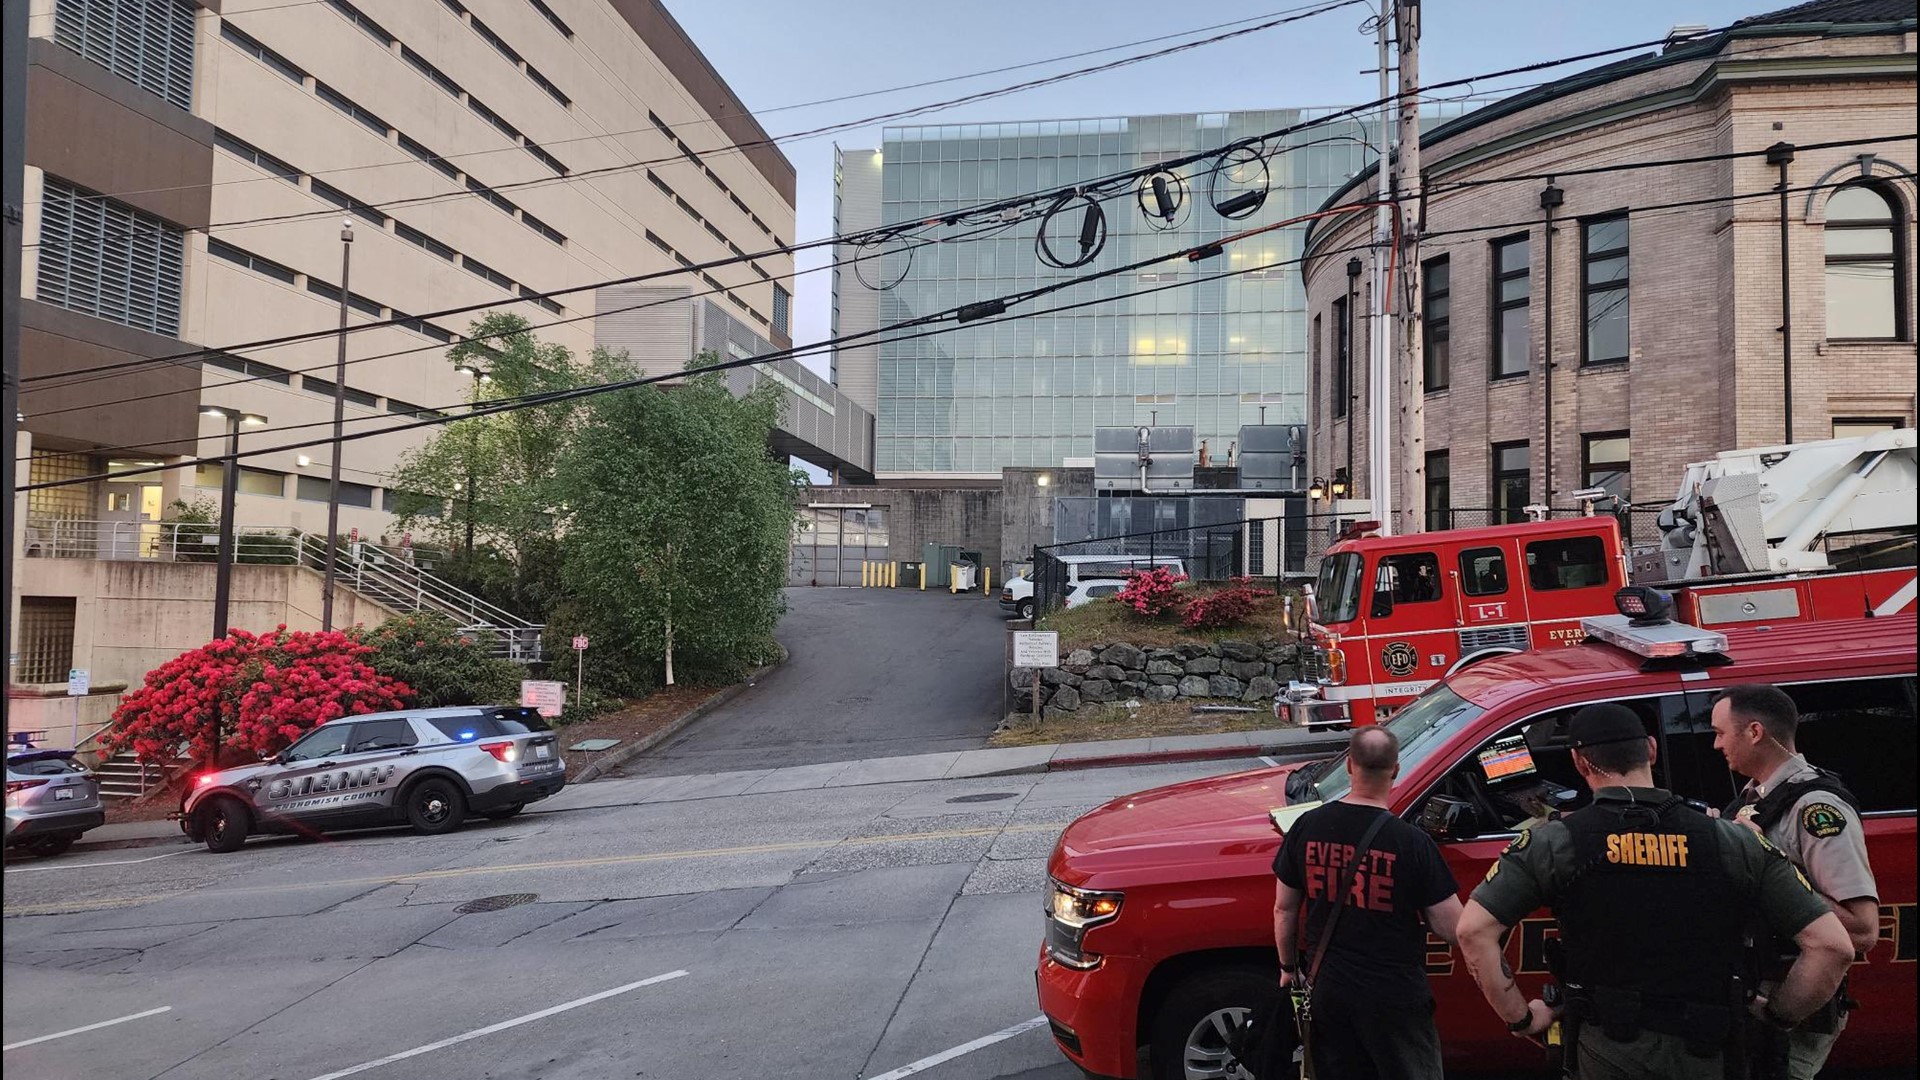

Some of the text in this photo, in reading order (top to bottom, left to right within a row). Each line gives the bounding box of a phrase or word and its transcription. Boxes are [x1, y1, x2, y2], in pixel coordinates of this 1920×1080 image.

[1478, 604, 1504, 619] L-1
[1391, 652, 1409, 666] EFD
[1384, 684, 1428, 695] INTEGRITY
[268, 764, 395, 800] SHERIFF
[343, 789, 387, 802] COUNTY
[1606, 832, 1689, 868] SHERIFF
[1305, 864, 1395, 913] FIRE
